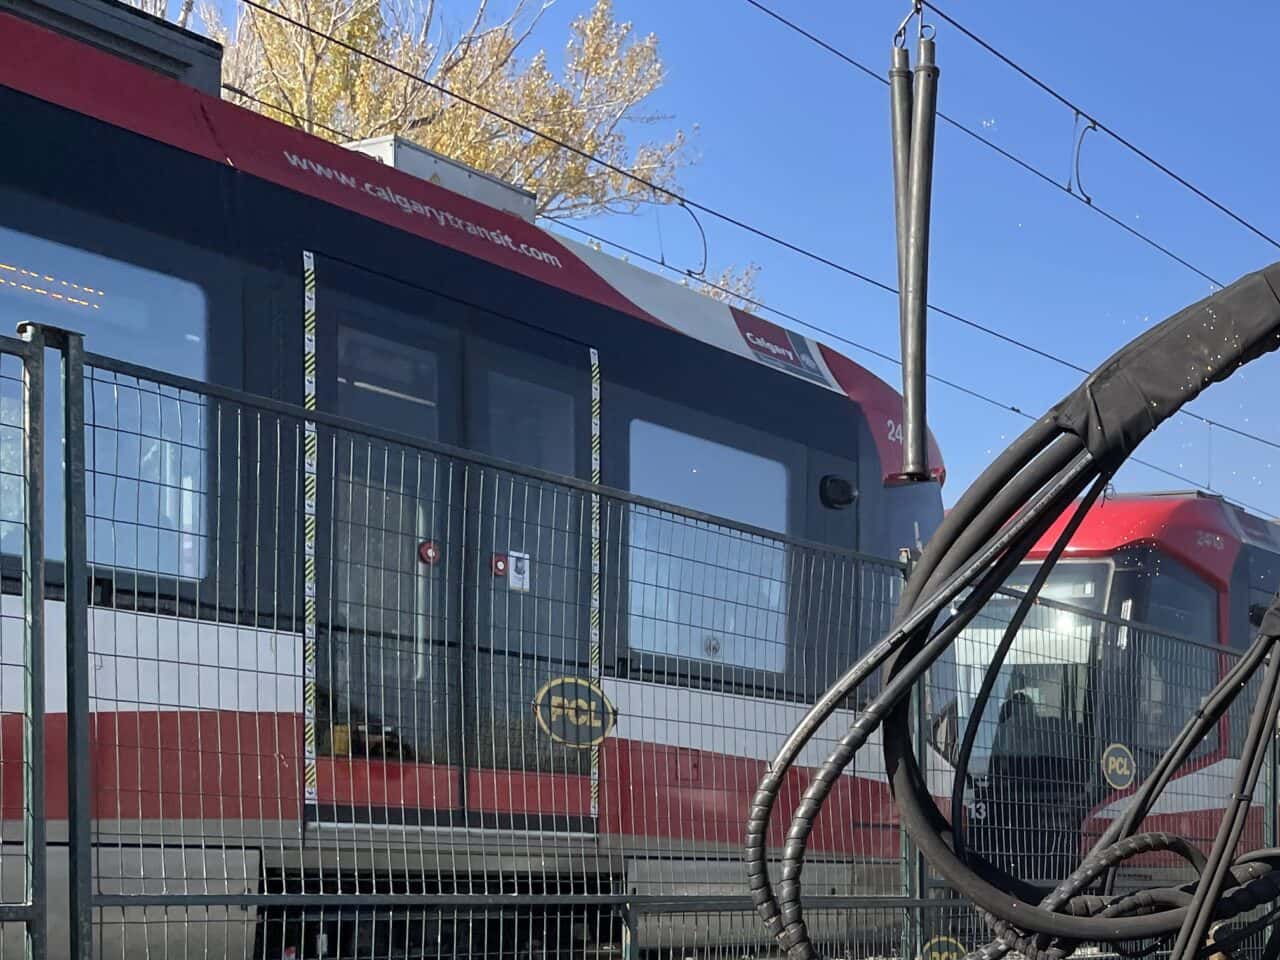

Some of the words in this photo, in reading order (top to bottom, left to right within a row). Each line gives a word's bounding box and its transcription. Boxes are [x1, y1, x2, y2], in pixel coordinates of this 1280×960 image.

[284, 150, 563, 269] www.calgarytransit.com
[746, 332, 794, 360] Calgary
[551, 695, 602, 728] PCL
[1108, 756, 1131, 775] PCL
